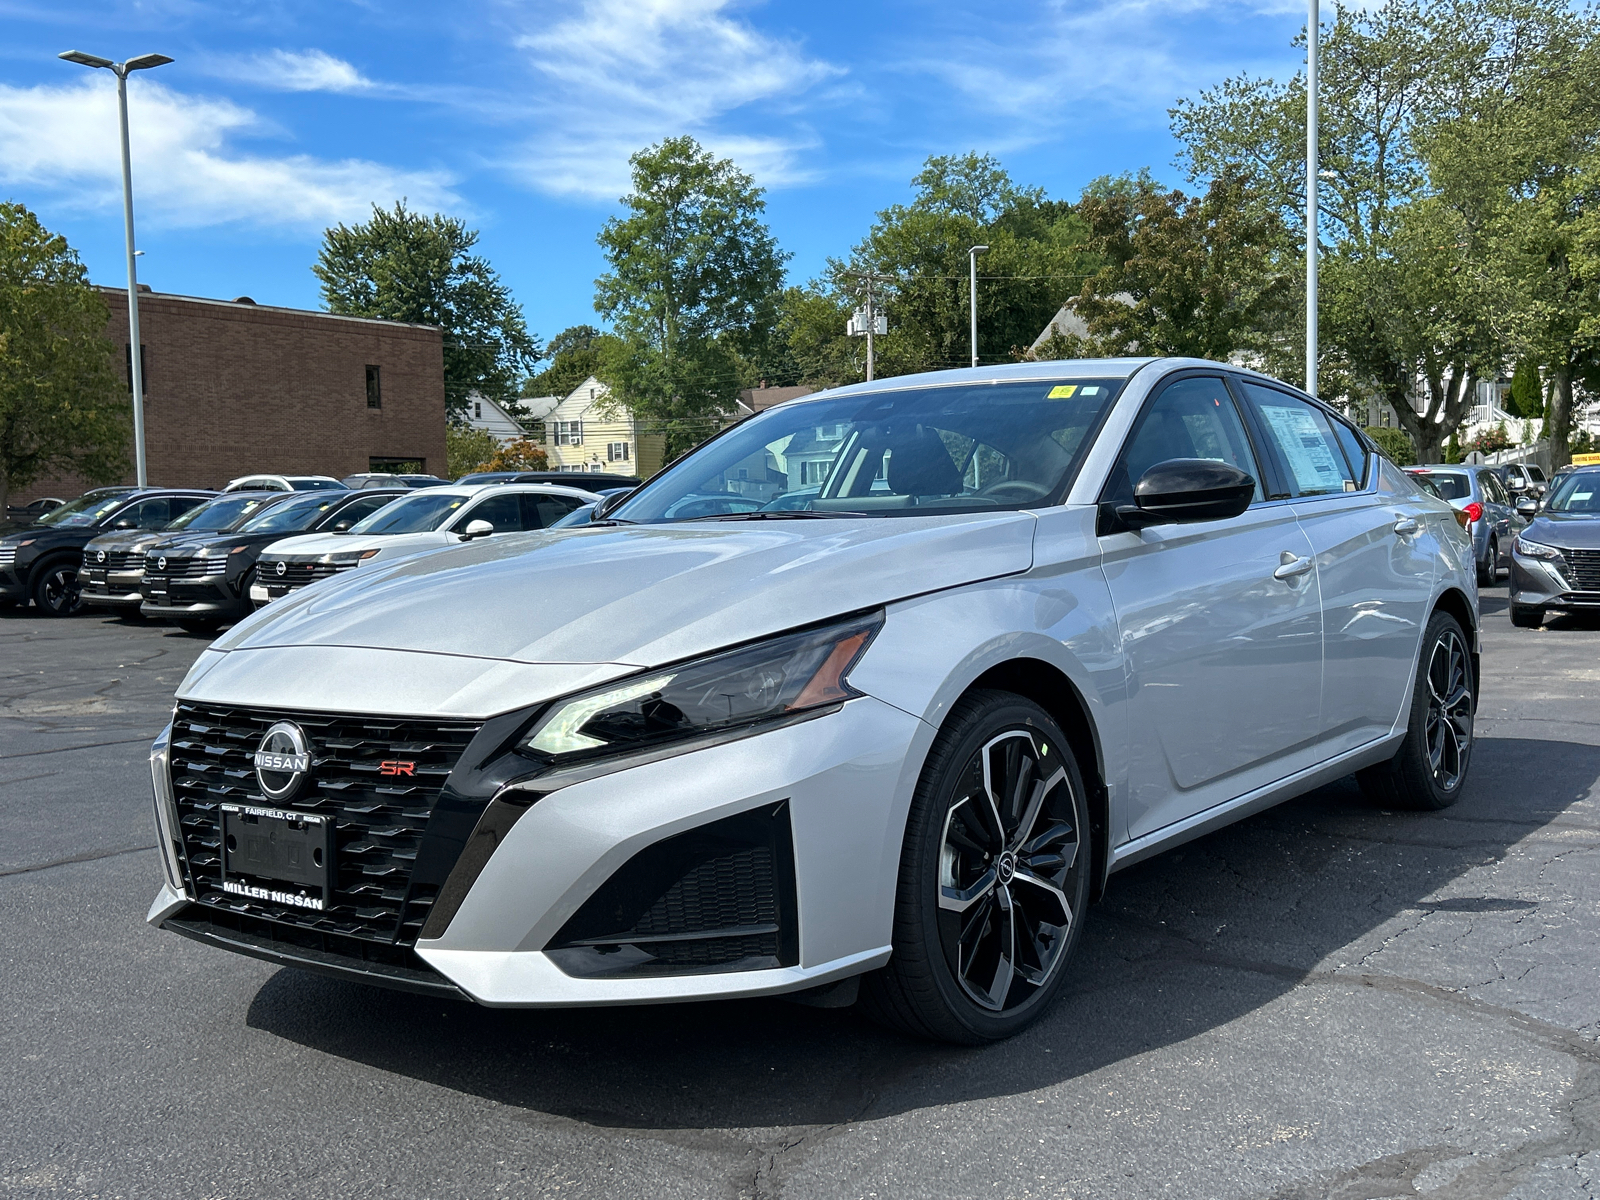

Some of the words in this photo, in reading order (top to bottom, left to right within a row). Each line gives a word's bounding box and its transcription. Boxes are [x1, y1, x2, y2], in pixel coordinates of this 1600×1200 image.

[254, 754, 307, 770] NISSAN
[380, 760, 415, 776] SR
[245, 807, 285, 820] FAIRFIELD,
[286, 813, 297, 821] CT
[223, 881, 269, 900] MILLER
[271, 890, 323, 910] NISSAN
